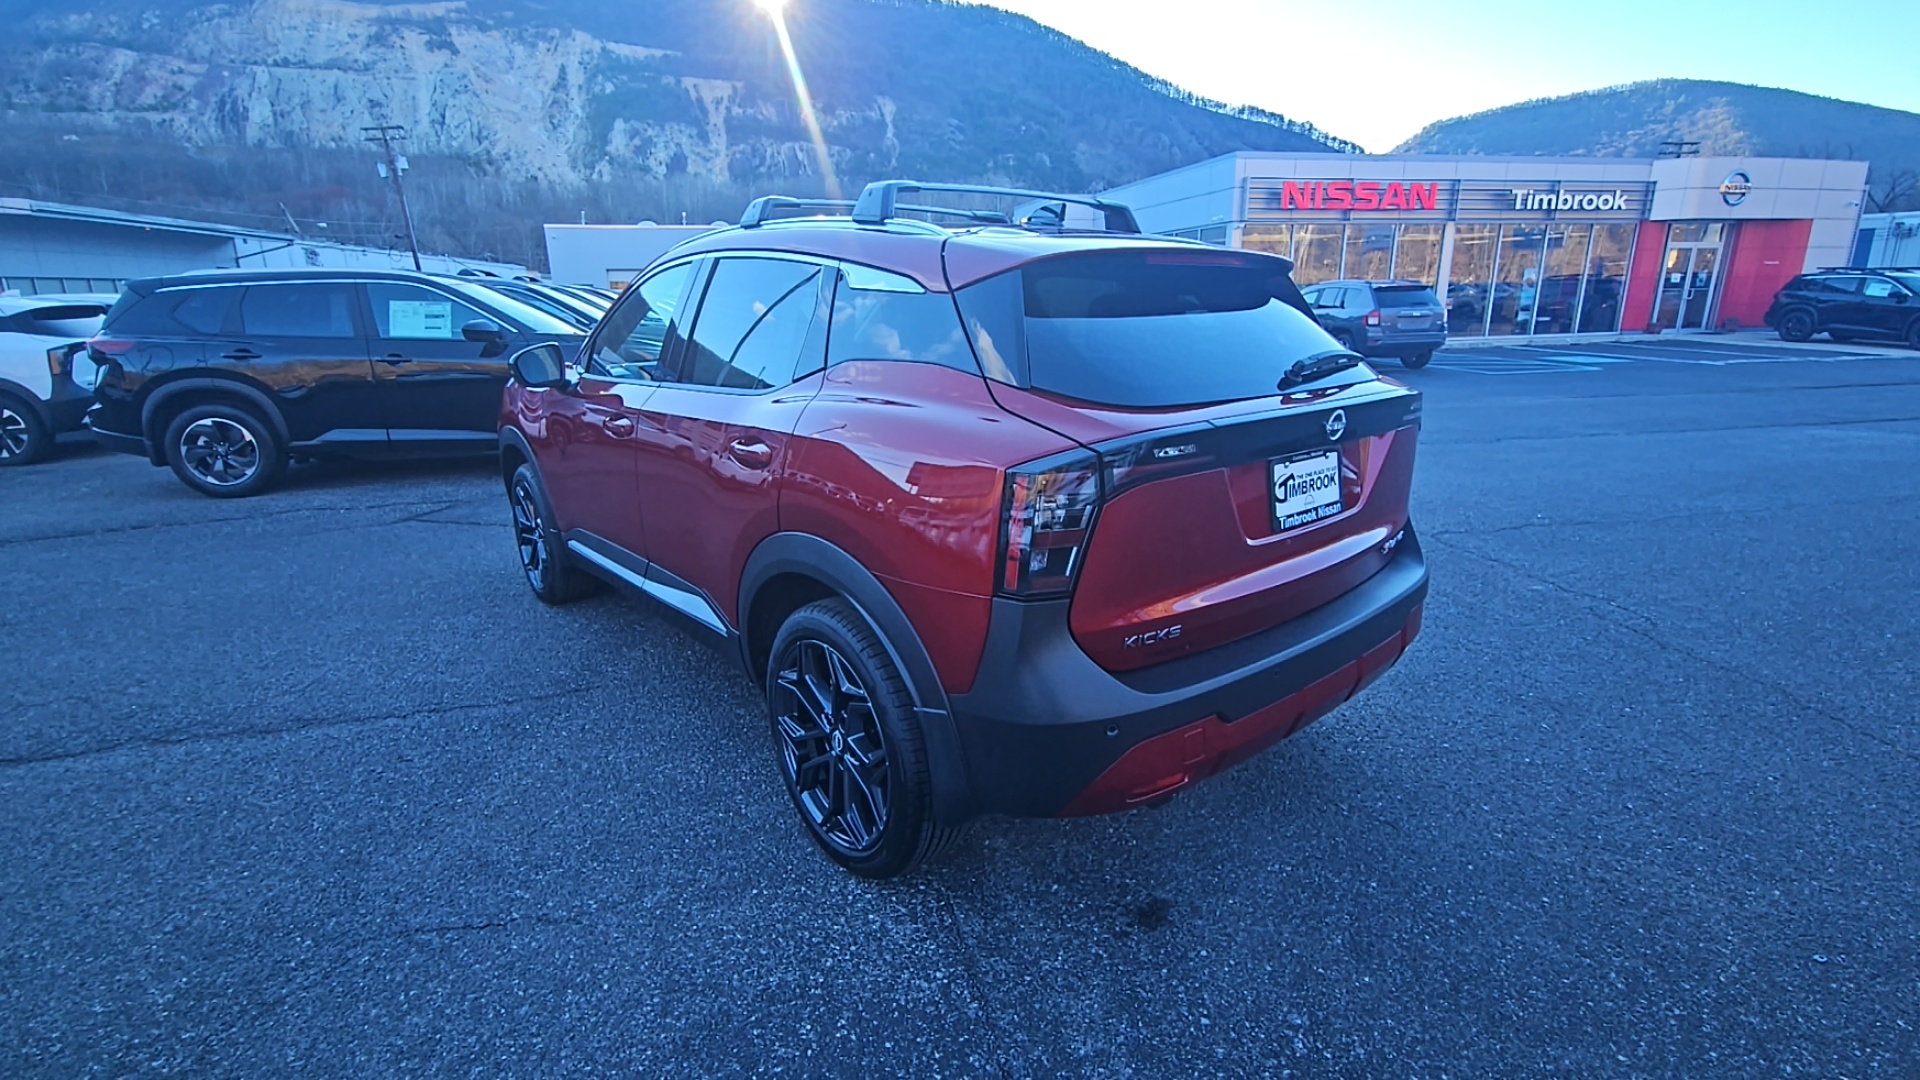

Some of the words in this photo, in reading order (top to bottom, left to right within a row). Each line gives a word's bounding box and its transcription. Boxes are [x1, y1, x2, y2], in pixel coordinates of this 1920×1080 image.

[1281, 181, 1438, 211] NISSAN
[1511, 189, 1628, 210] Timbrook
[1279, 509, 1317, 530] Timbrook
[1317, 502, 1342, 518] Nissan
[1124, 624, 1182, 650] KICKS
